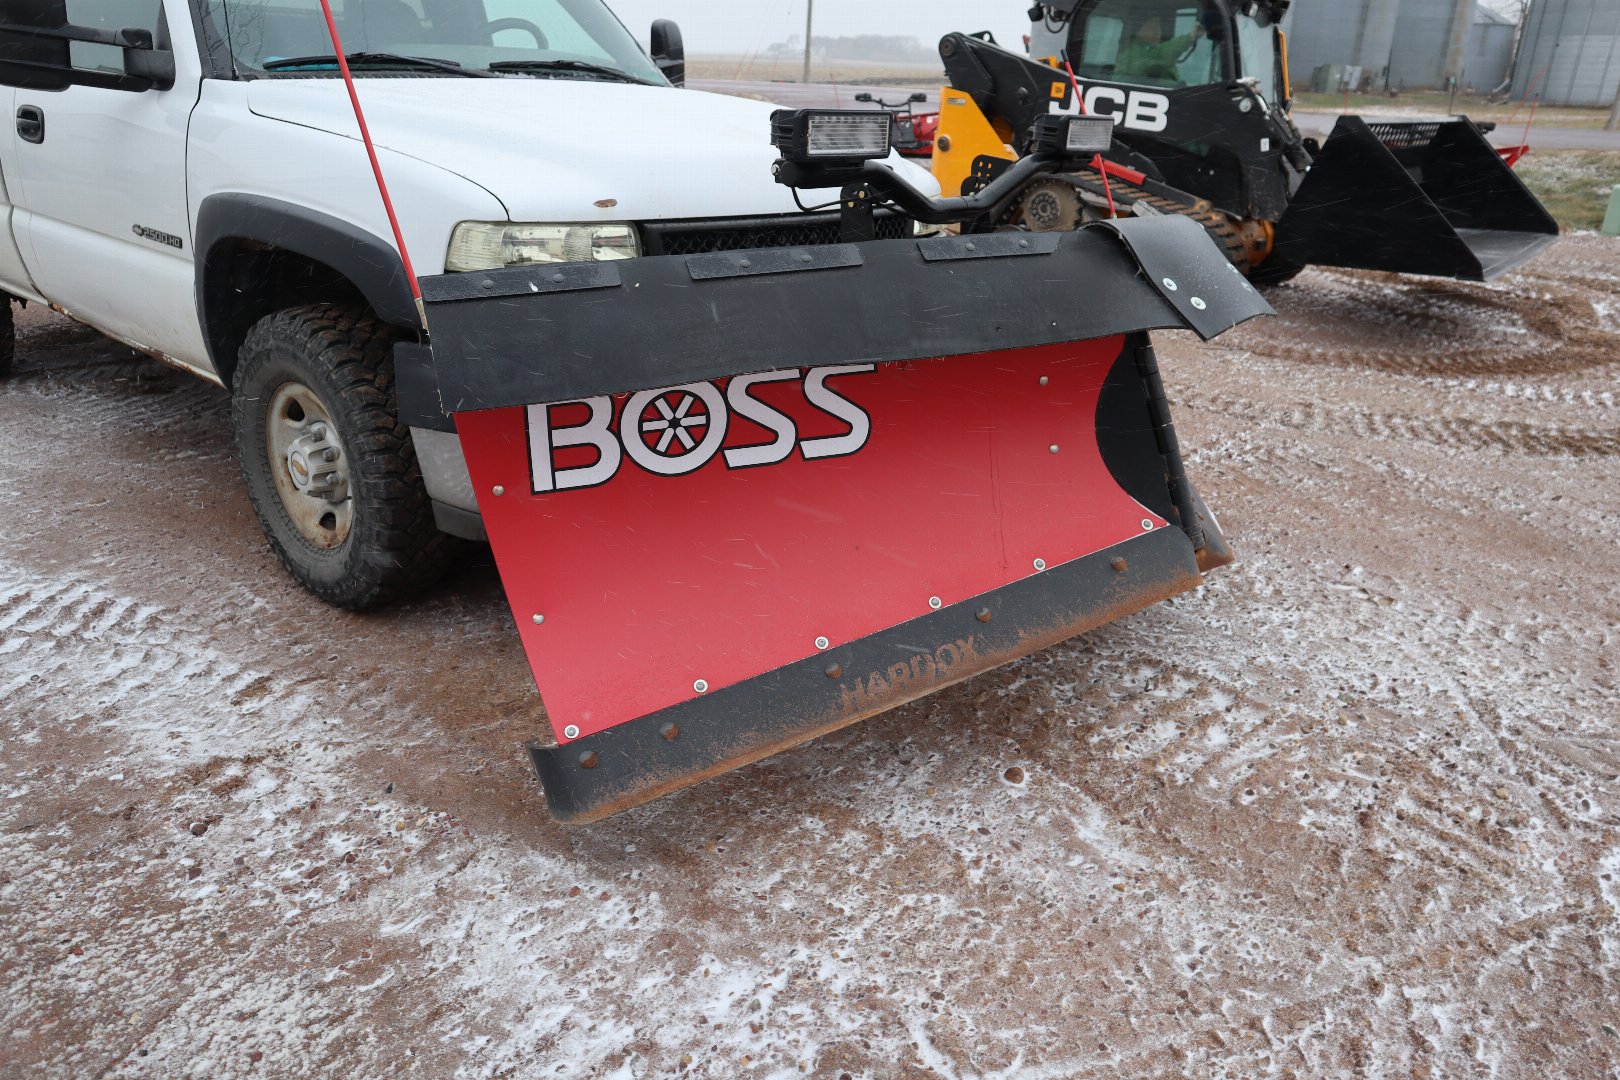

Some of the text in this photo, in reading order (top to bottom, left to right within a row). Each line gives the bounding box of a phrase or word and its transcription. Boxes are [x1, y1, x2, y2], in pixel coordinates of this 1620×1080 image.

[1048, 84, 1170, 133] JCB
[143, 227, 168, 244] 2500
[524, 363, 877, 495] BOSS
[837, 634, 978, 713] HARDOX
